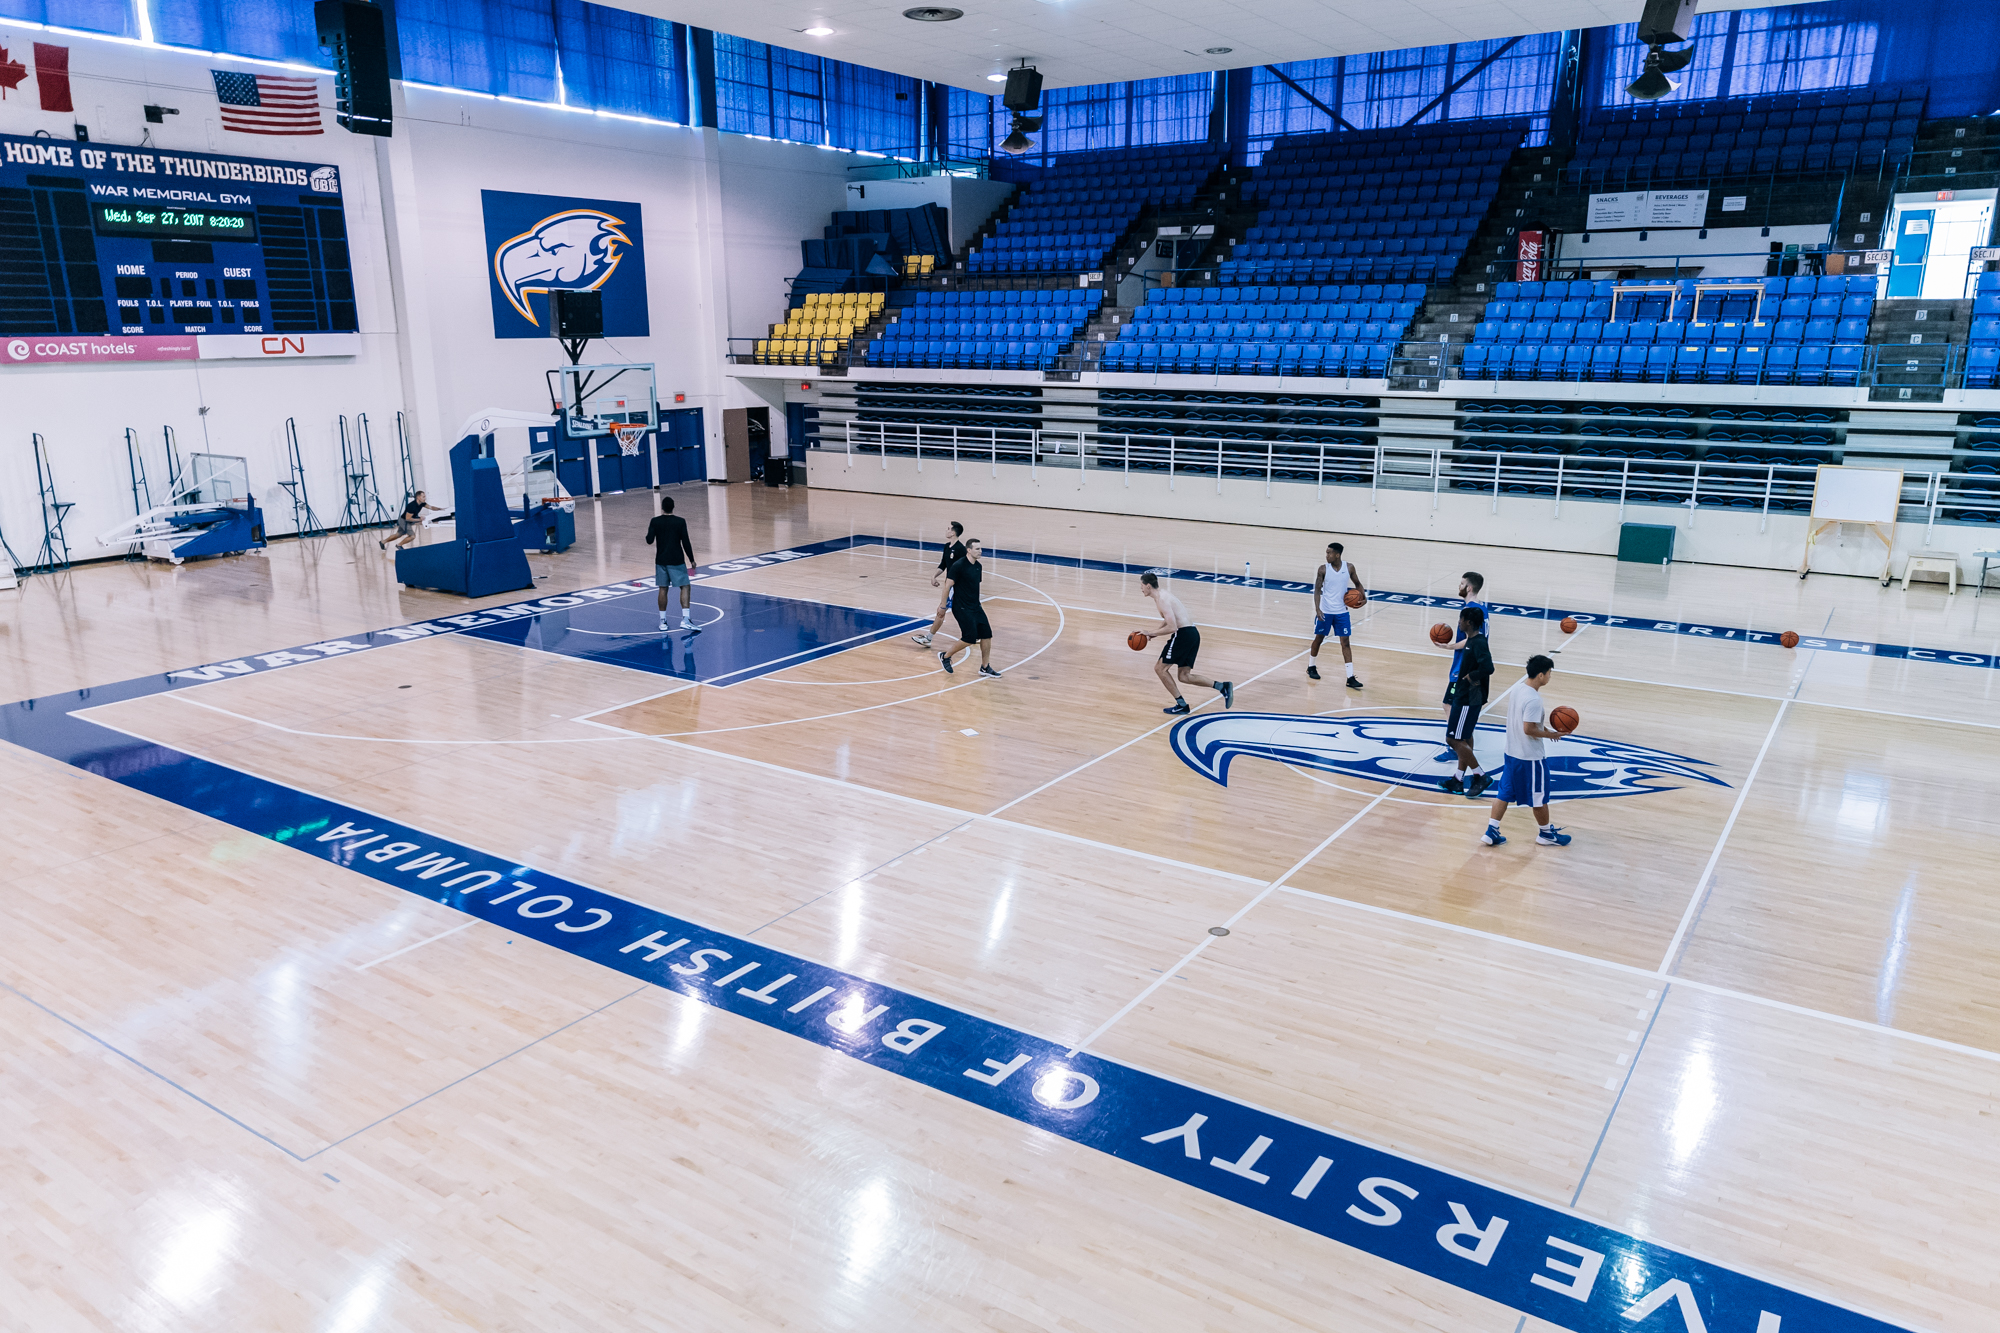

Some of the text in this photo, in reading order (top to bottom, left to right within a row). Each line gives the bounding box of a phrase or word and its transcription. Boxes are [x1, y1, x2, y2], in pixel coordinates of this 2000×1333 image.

[4, 142, 308, 186] HOME OF THE THUNDERBIRDS
[90, 184, 251, 205] WAR MEMORIAL GYM
[311, 178, 338, 193] UBC
[104, 208, 131, 223] Wed,
[161, 211, 179, 226] 27,
[183, 213, 205, 228] 2017
[209, 215, 245, 229] 8:20:20
[1158, 242, 1163, 255] 7
[1866, 252, 1888, 261] SEC.13
[1973, 251, 1995, 259] SEC.11
[116, 264, 146, 275] HOME
[175, 271, 198, 279] PERIOD
[223, 267, 251, 278] GUEST
[35, 342, 135, 356] COAST hotels
[261, 336, 305, 354] CN
[167, 640, 372, 681] WAR
[708, 550, 814, 571] GYM
[1194, 573, 2000, 667] THE UVERSTY OF BRITSH CO
[315, 821, 613, 934] COLUMBIA
[618, 930, 946, 1054] BRITISH
[963, 1053, 1100, 1109] OF
